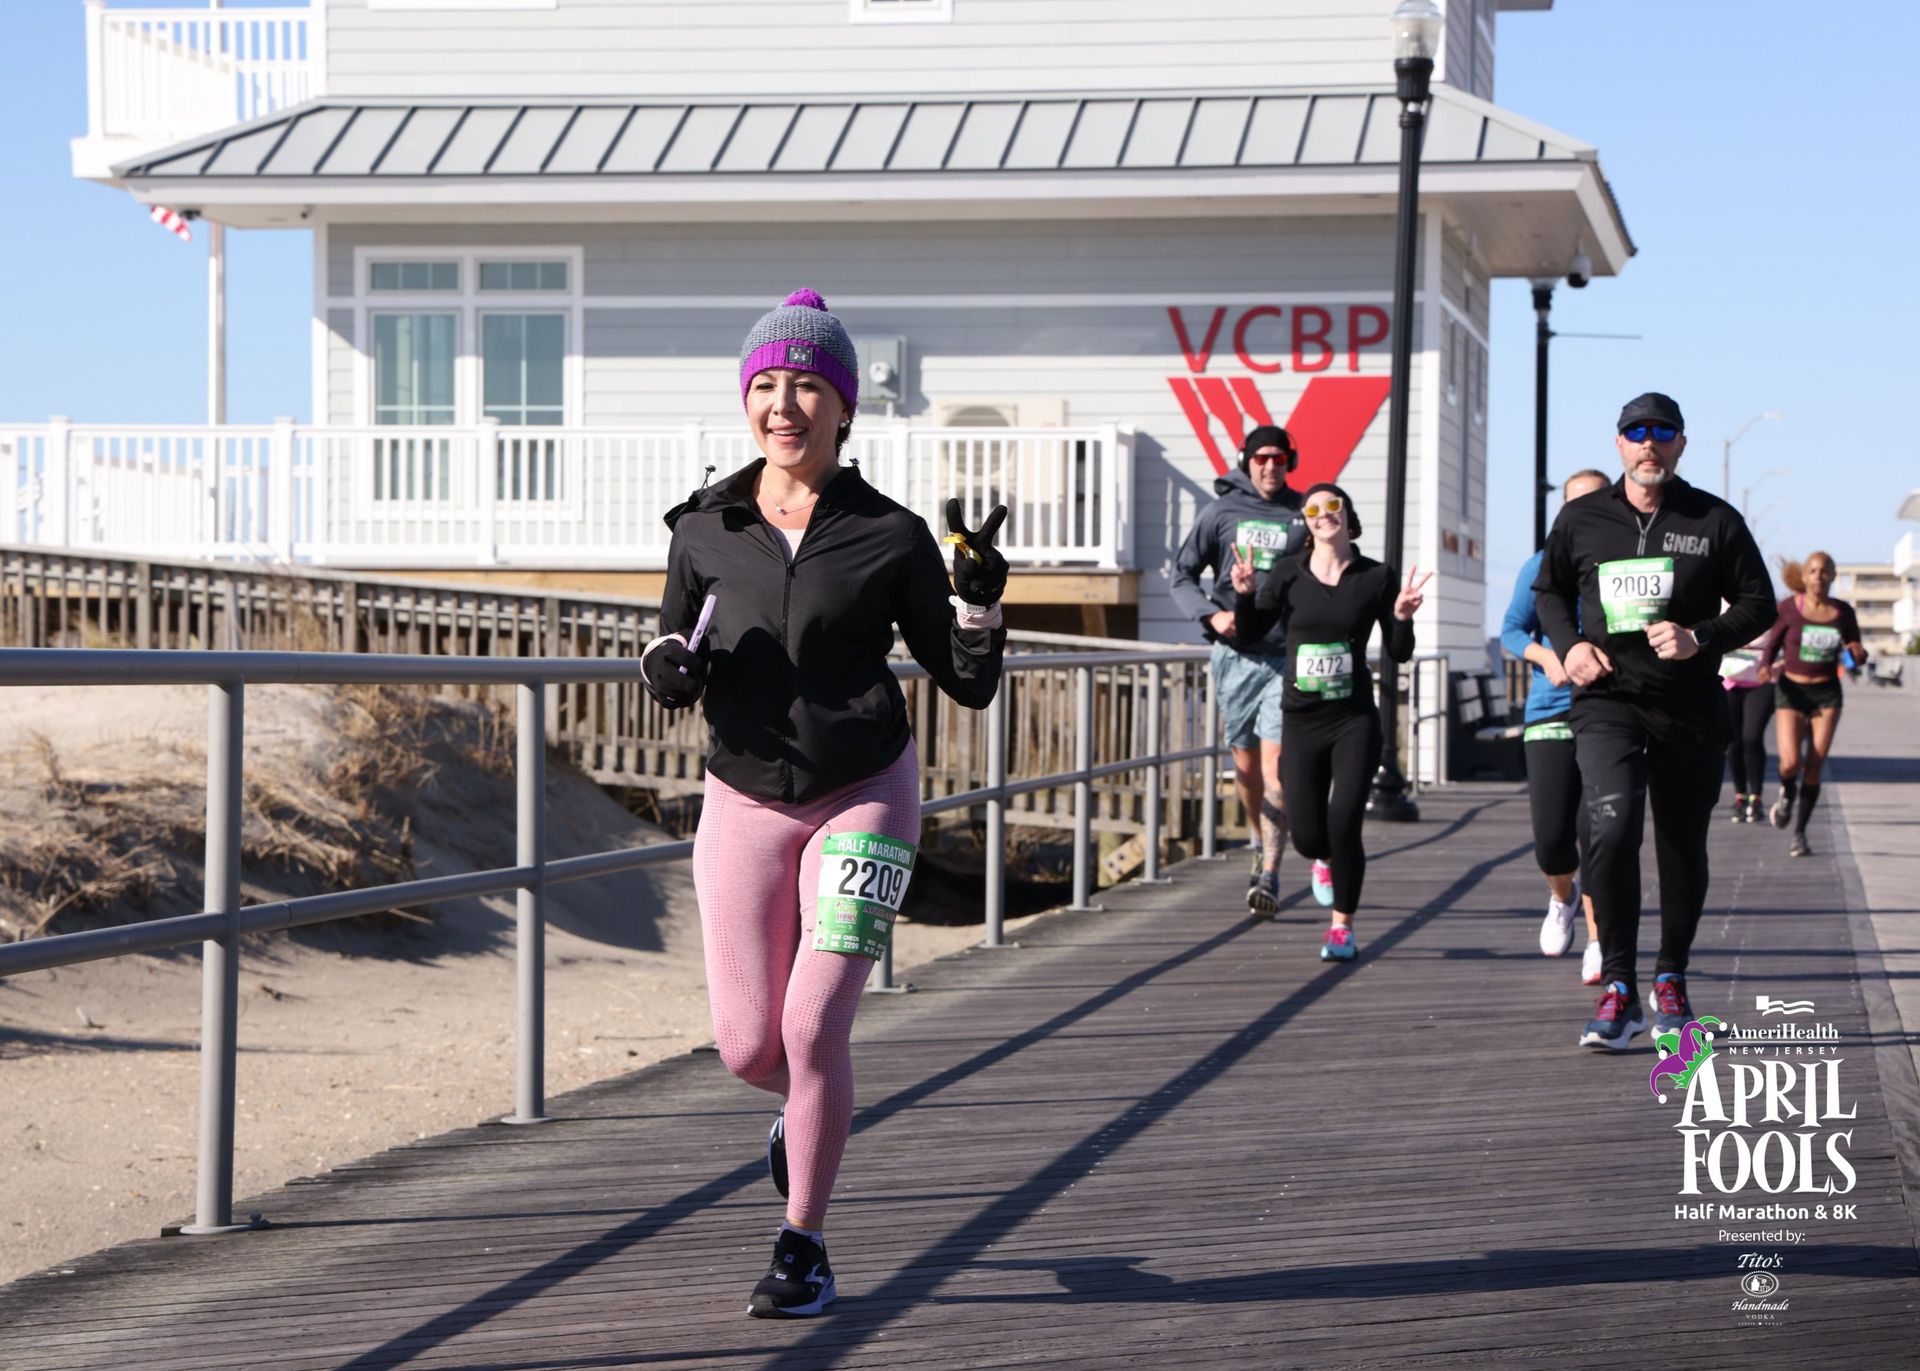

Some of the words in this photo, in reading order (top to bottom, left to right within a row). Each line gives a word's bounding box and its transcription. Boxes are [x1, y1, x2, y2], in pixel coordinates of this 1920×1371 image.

[1167, 305, 1390, 374] VCBP
[1246, 530, 1279, 546] 2497
[1672, 533, 1710, 557] NBA
[1612, 574, 1661, 598] 2003
[1306, 656, 1344, 675] 2472
[838, 839, 867, 853] HALF
[868, 841, 912, 865] MARATHON
[838, 858, 904, 906] 2209
